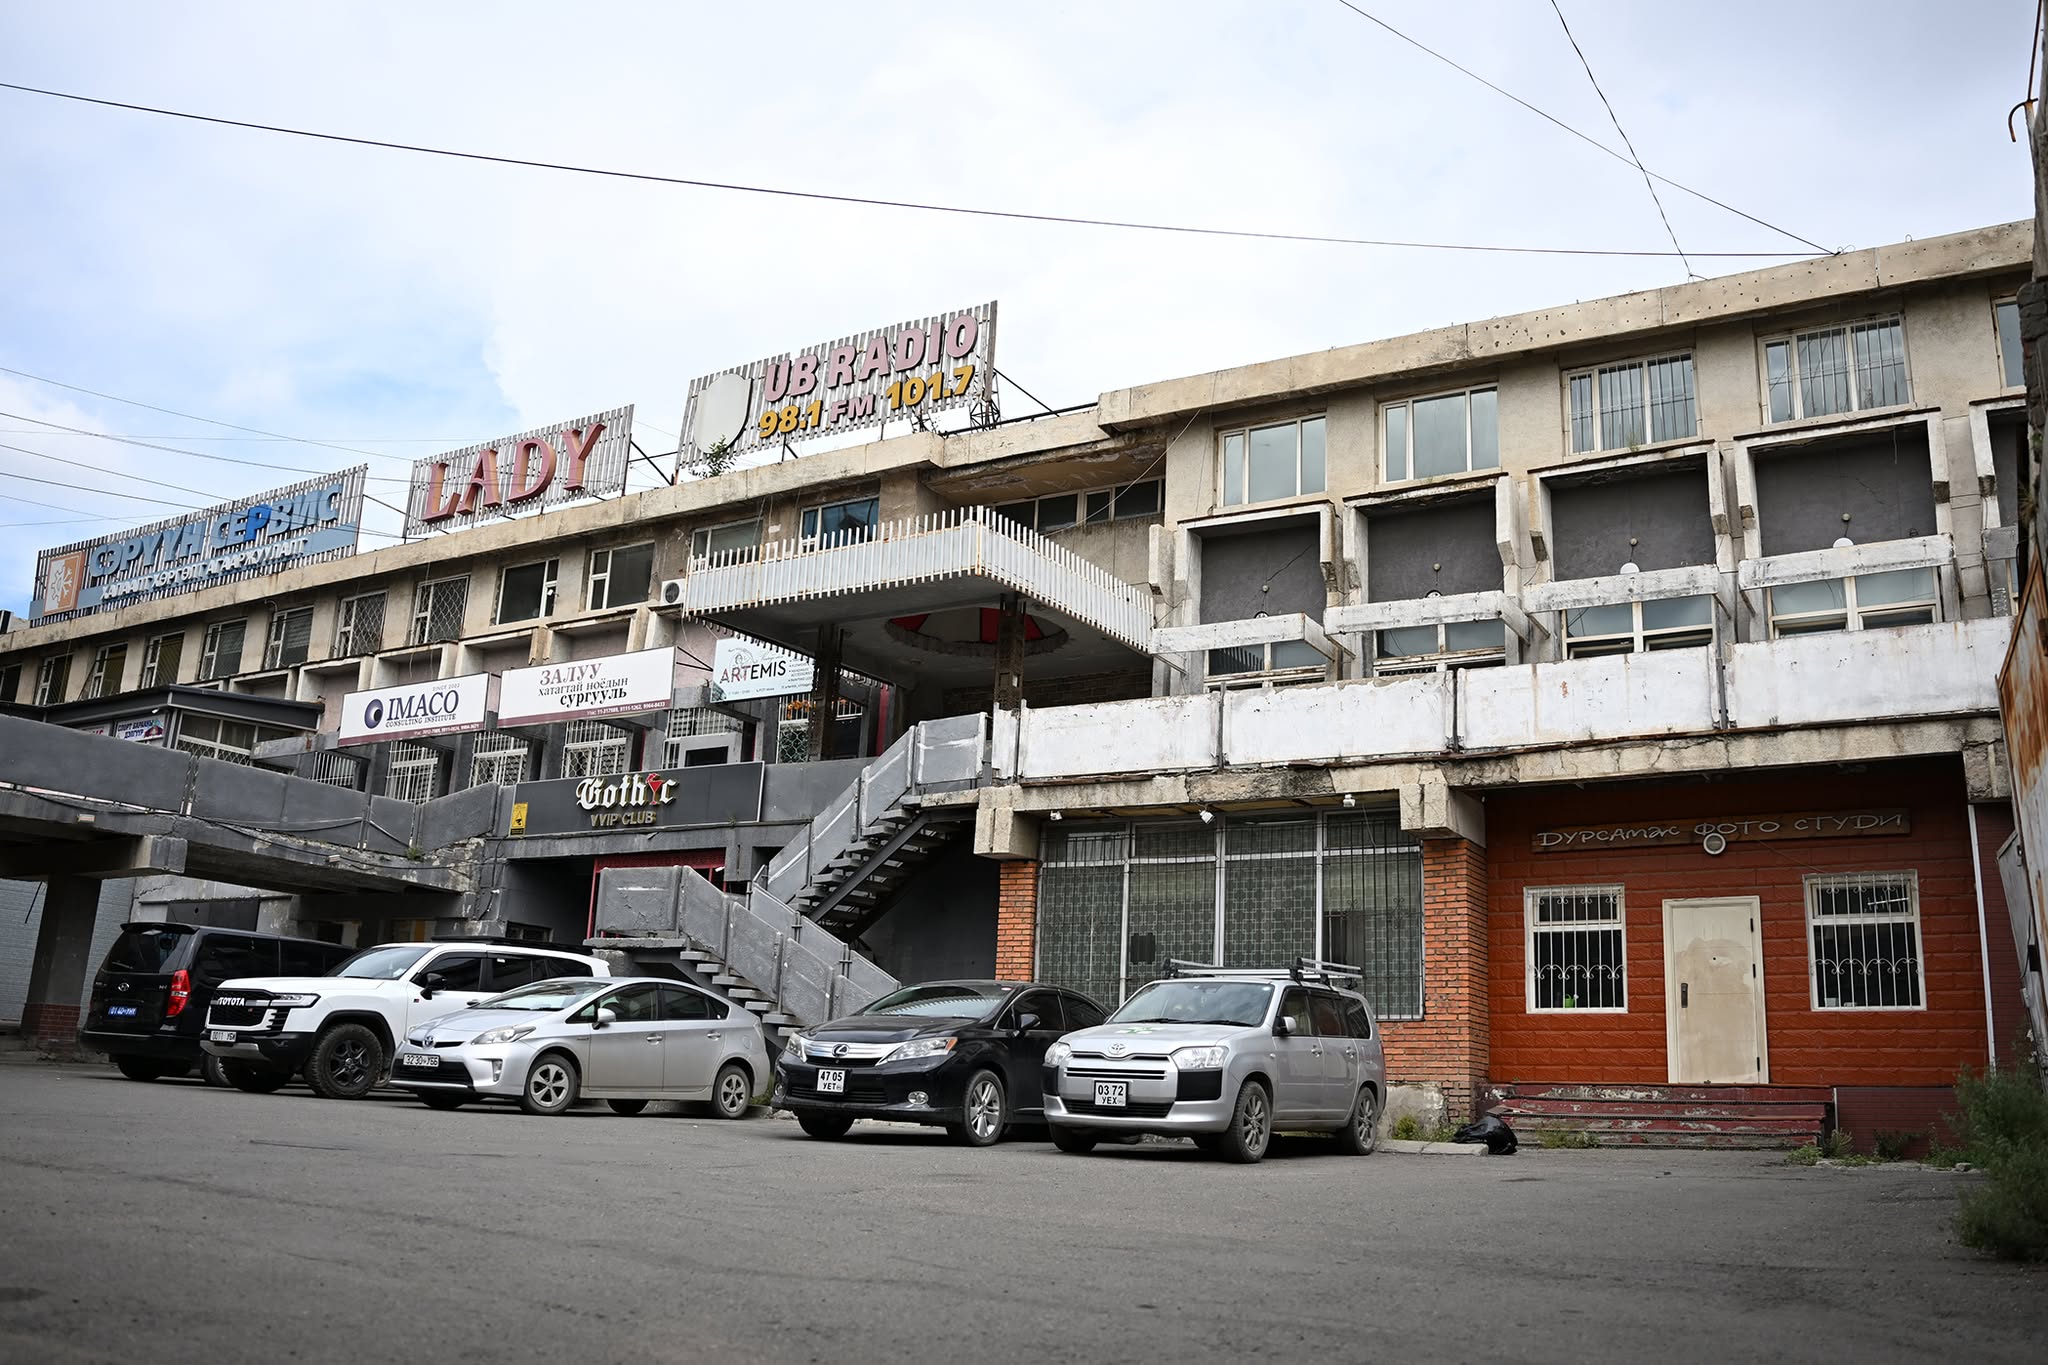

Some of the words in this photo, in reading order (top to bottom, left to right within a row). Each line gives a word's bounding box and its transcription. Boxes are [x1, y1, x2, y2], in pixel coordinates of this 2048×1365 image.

[763, 354, 819, 402] UB
[827, 314, 979, 389] RADIO
[759, 399, 823, 439] 98.1
[829, 395, 875, 423] FM
[886, 365, 975, 410] 101.7
[421, 422, 607, 522] LADY
[89, 520, 206, 577] СЭРҮҮН
[211, 483, 342, 549] СЕРВИС
[539, 663, 602, 685] ЗАЛУУ
[719, 660, 787, 684] ARTEMIS
[538, 681, 583, 696] хатагтай
[586, 678, 628, 691] ноёдын
[560, 687, 627, 708] сургууль
[387, 690, 459, 721] IMACO
[385, 717, 422, 728] CONSULTING
[424, 713, 457, 723] INSTITUTE
[621, 811, 657, 825] CLUB
[1694, 820, 1780, 836] ФОТО
[1794, 814, 1903, 831] СТУДИ
[217, 996, 245, 1006] TOYOTA
